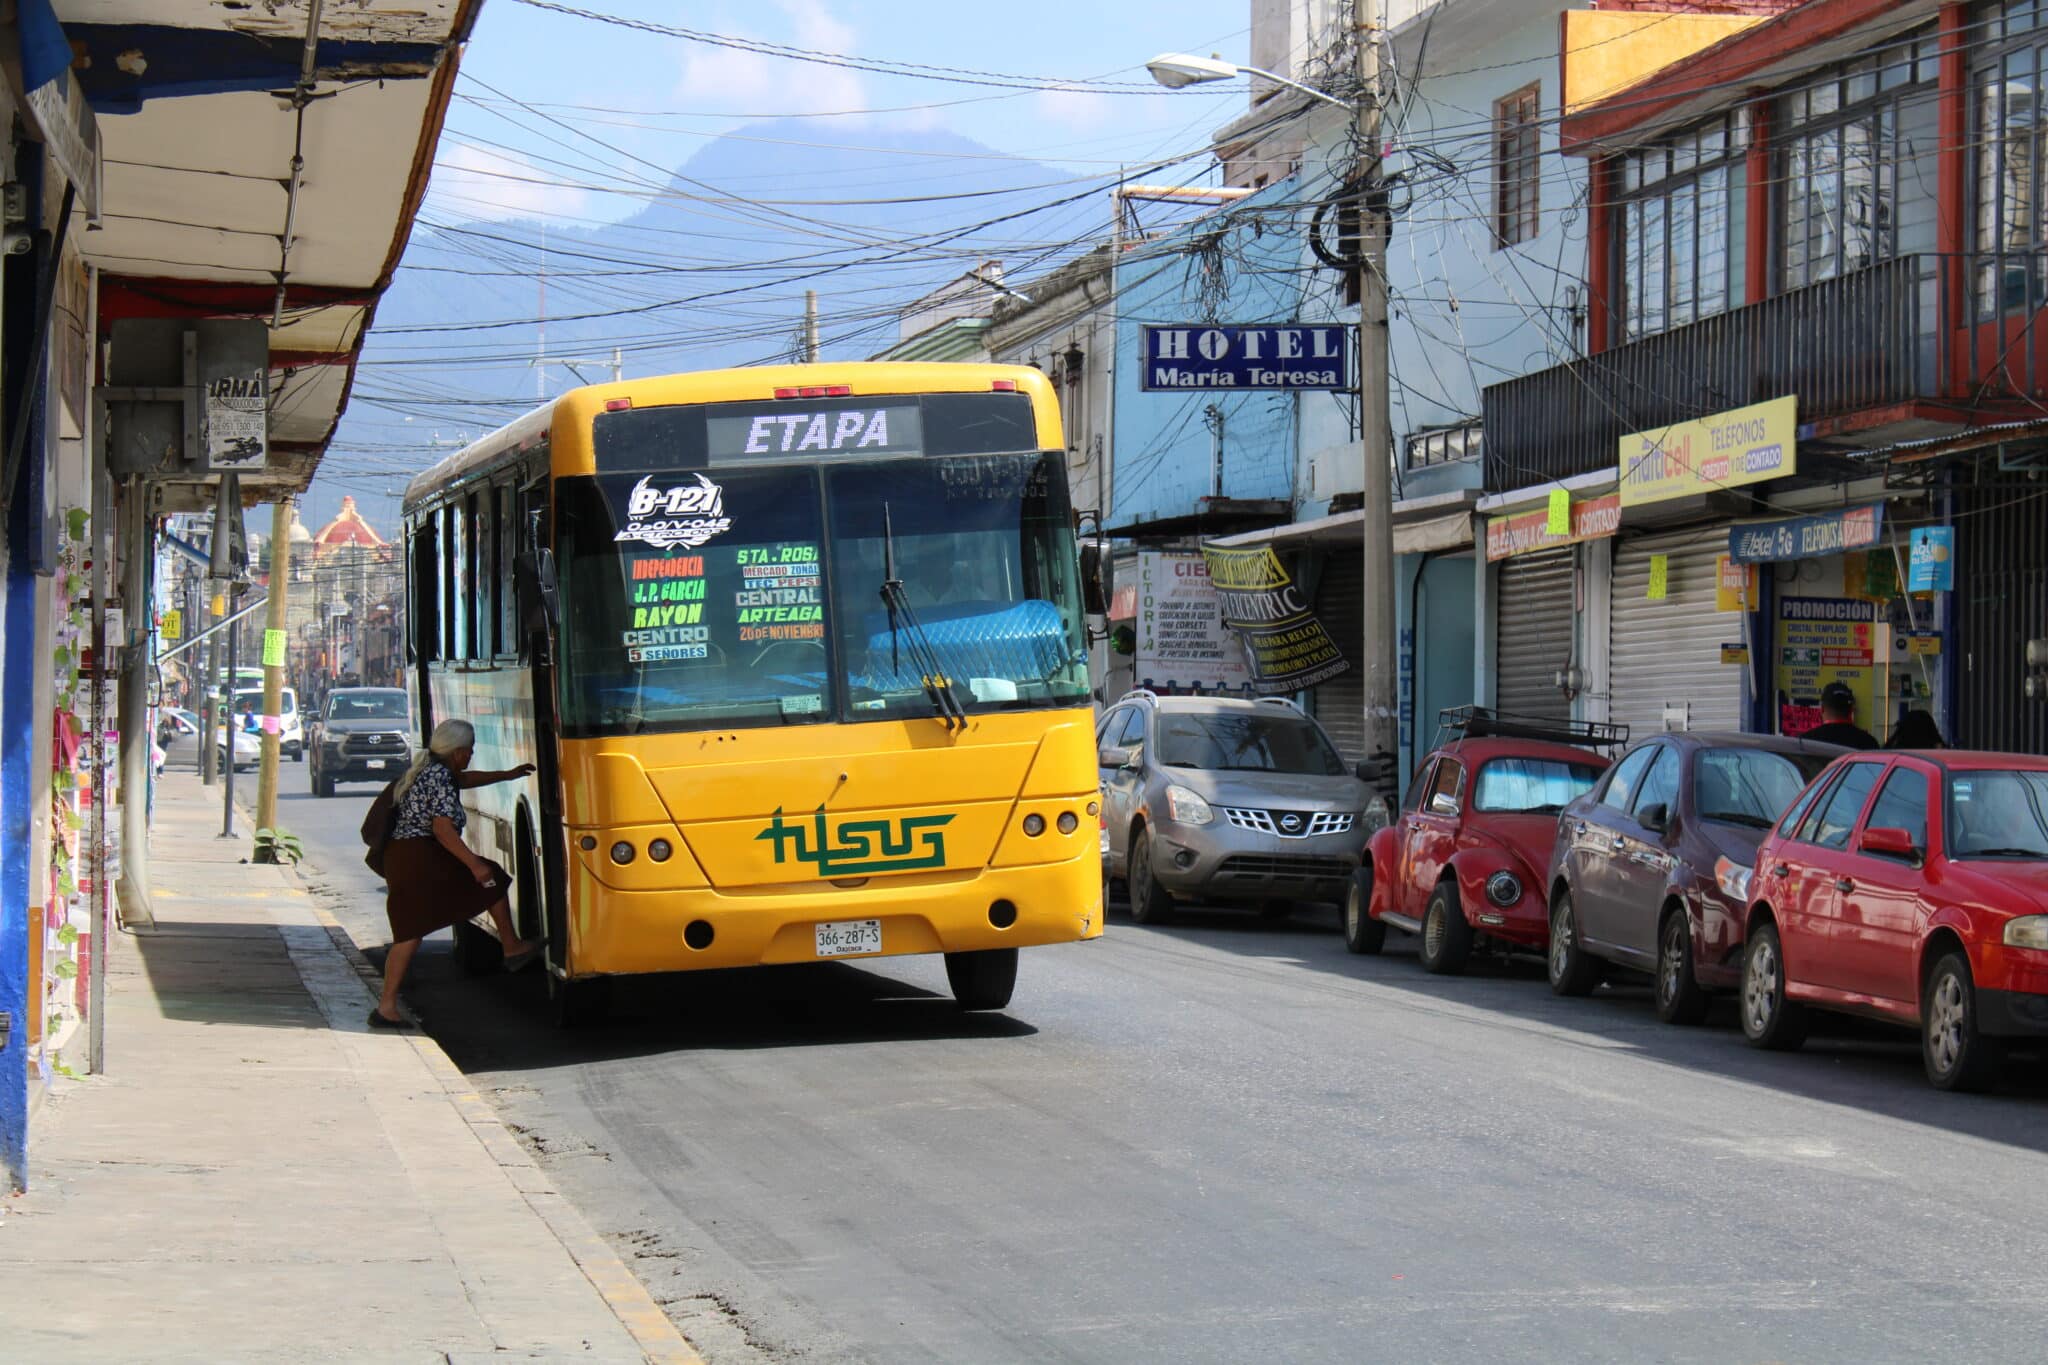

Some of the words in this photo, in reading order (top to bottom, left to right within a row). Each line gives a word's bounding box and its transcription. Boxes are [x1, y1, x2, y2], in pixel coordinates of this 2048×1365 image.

[1156, 329, 1338, 360] HOTEL
[1156, 367, 1235, 386] María
[1247, 367, 1336, 386] Teresa
[745, 410, 889, 453] ETAPA
[1736, 458, 1744, 472] DE
[1746, 448, 1781, 470] CONTADO
[629, 486, 721, 516] B-121
[1778, 526, 1792, 556] 5G
[633, 556, 704, 579] INDEPENDENCIA
[744, 566, 788, 577] MERCADO
[791, 564, 818, 575] ZONAL
[661, 580, 706, 601] GARCIA
[749, 579, 774, 589] TEC
[778, 577, 820, 587] PEPSI
[736, 589, 821, 607] CENTRAL
[1142, 555, 1154, 651] ICTORIA
[1783, 598, 1872, 619] PROMOCIÓN
[634, 603, 703, 629] RAYON
[737, 606, 823, 623] ARTEAGA
[623, 626, 709, 646] CENTRO
[740, 626, 755, 640] 20
[755, 626, 768, 640] DE
[630, 649, 641, 661] 5
[646, 646, 705, 659] SEÑORES
[1400, 628, 1412, 747] HOTEL
[818, 928, 879, 946] 366-287-S
